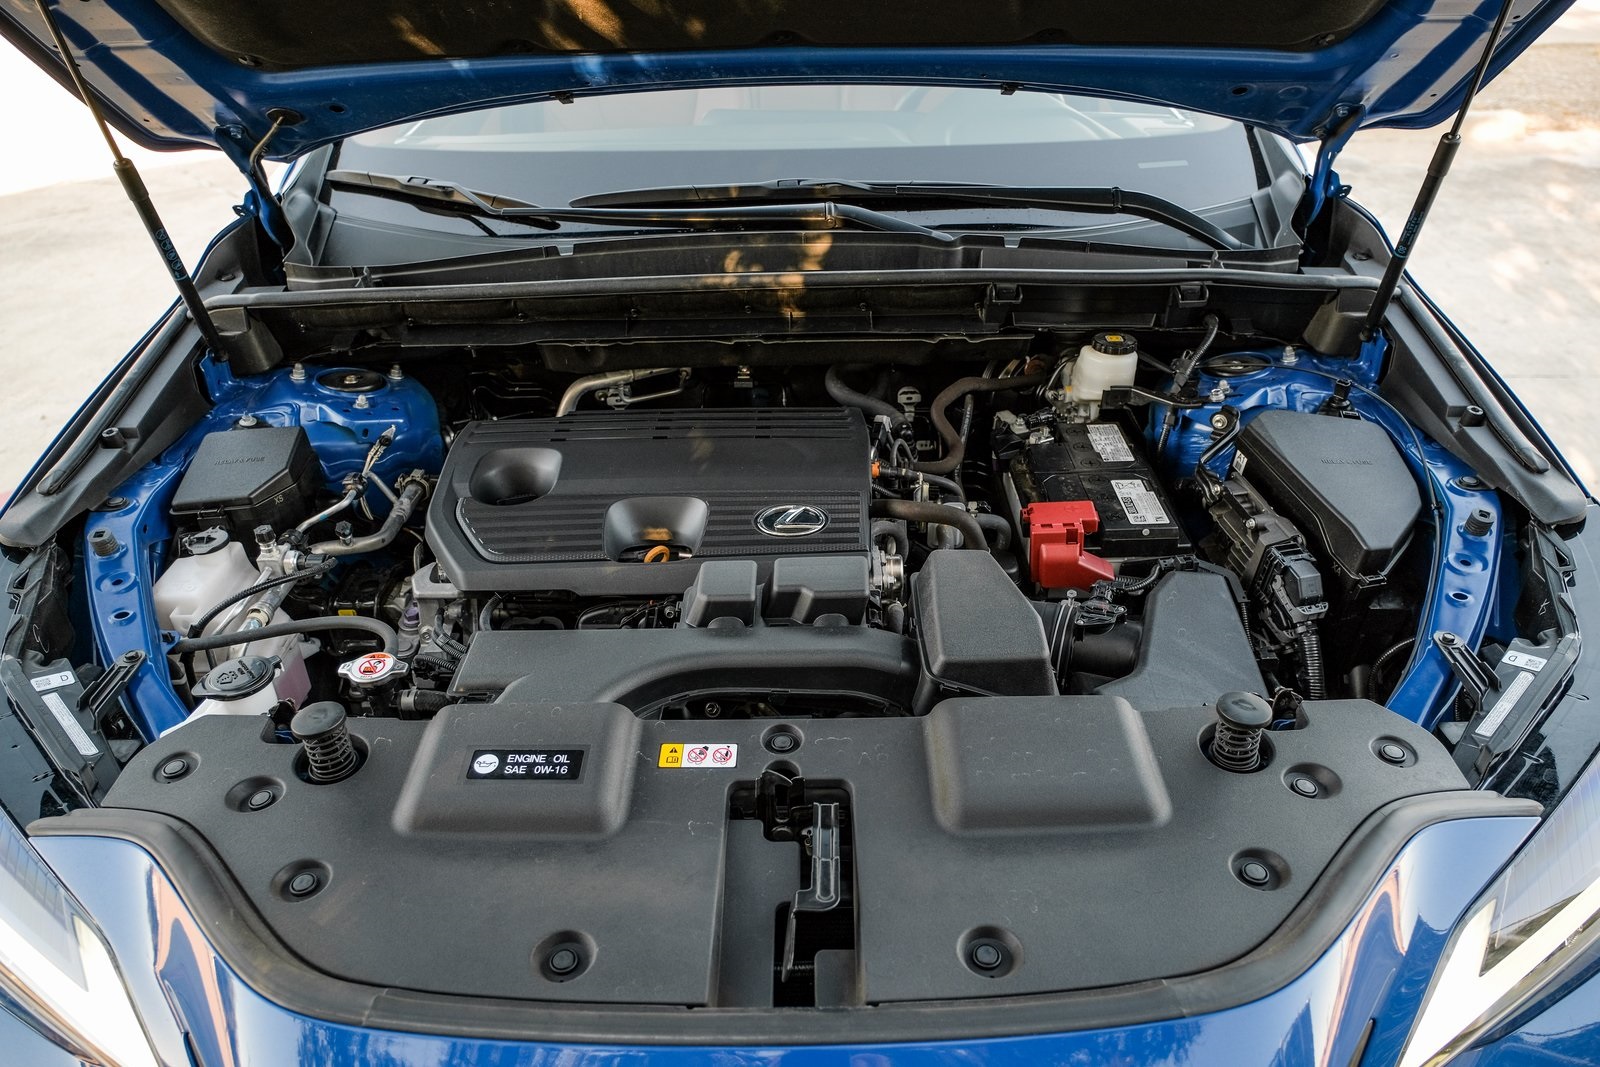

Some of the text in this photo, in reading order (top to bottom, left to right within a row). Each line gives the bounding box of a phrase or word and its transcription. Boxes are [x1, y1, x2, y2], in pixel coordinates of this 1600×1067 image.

[507, 754, 570, 763] ENGINE OIL
[504, 765, 568, 774] SAE 0W-16
